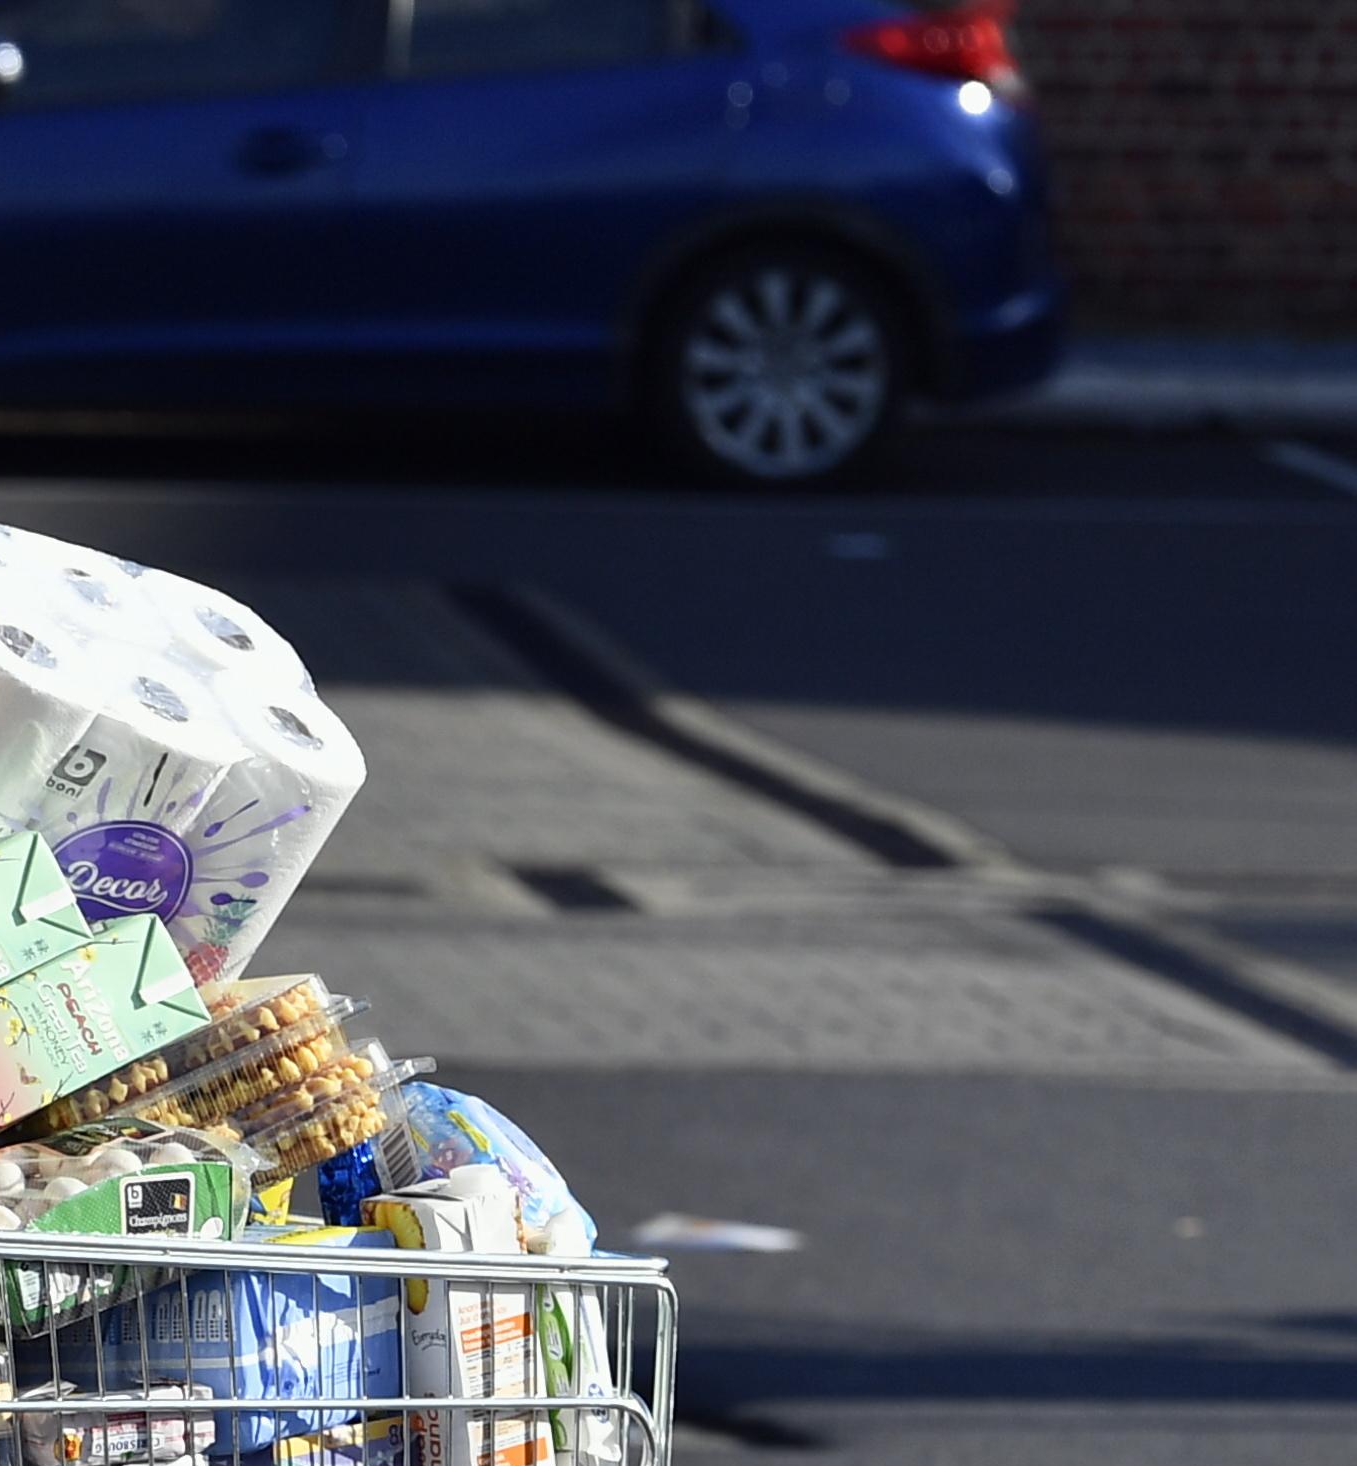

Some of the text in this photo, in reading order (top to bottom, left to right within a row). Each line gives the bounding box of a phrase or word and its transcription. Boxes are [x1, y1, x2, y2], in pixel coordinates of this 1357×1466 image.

[45, 776, 84, 799] boni
[68, 861, 168, 903] Decor
[57, 983, 102, 1055] PEACH
